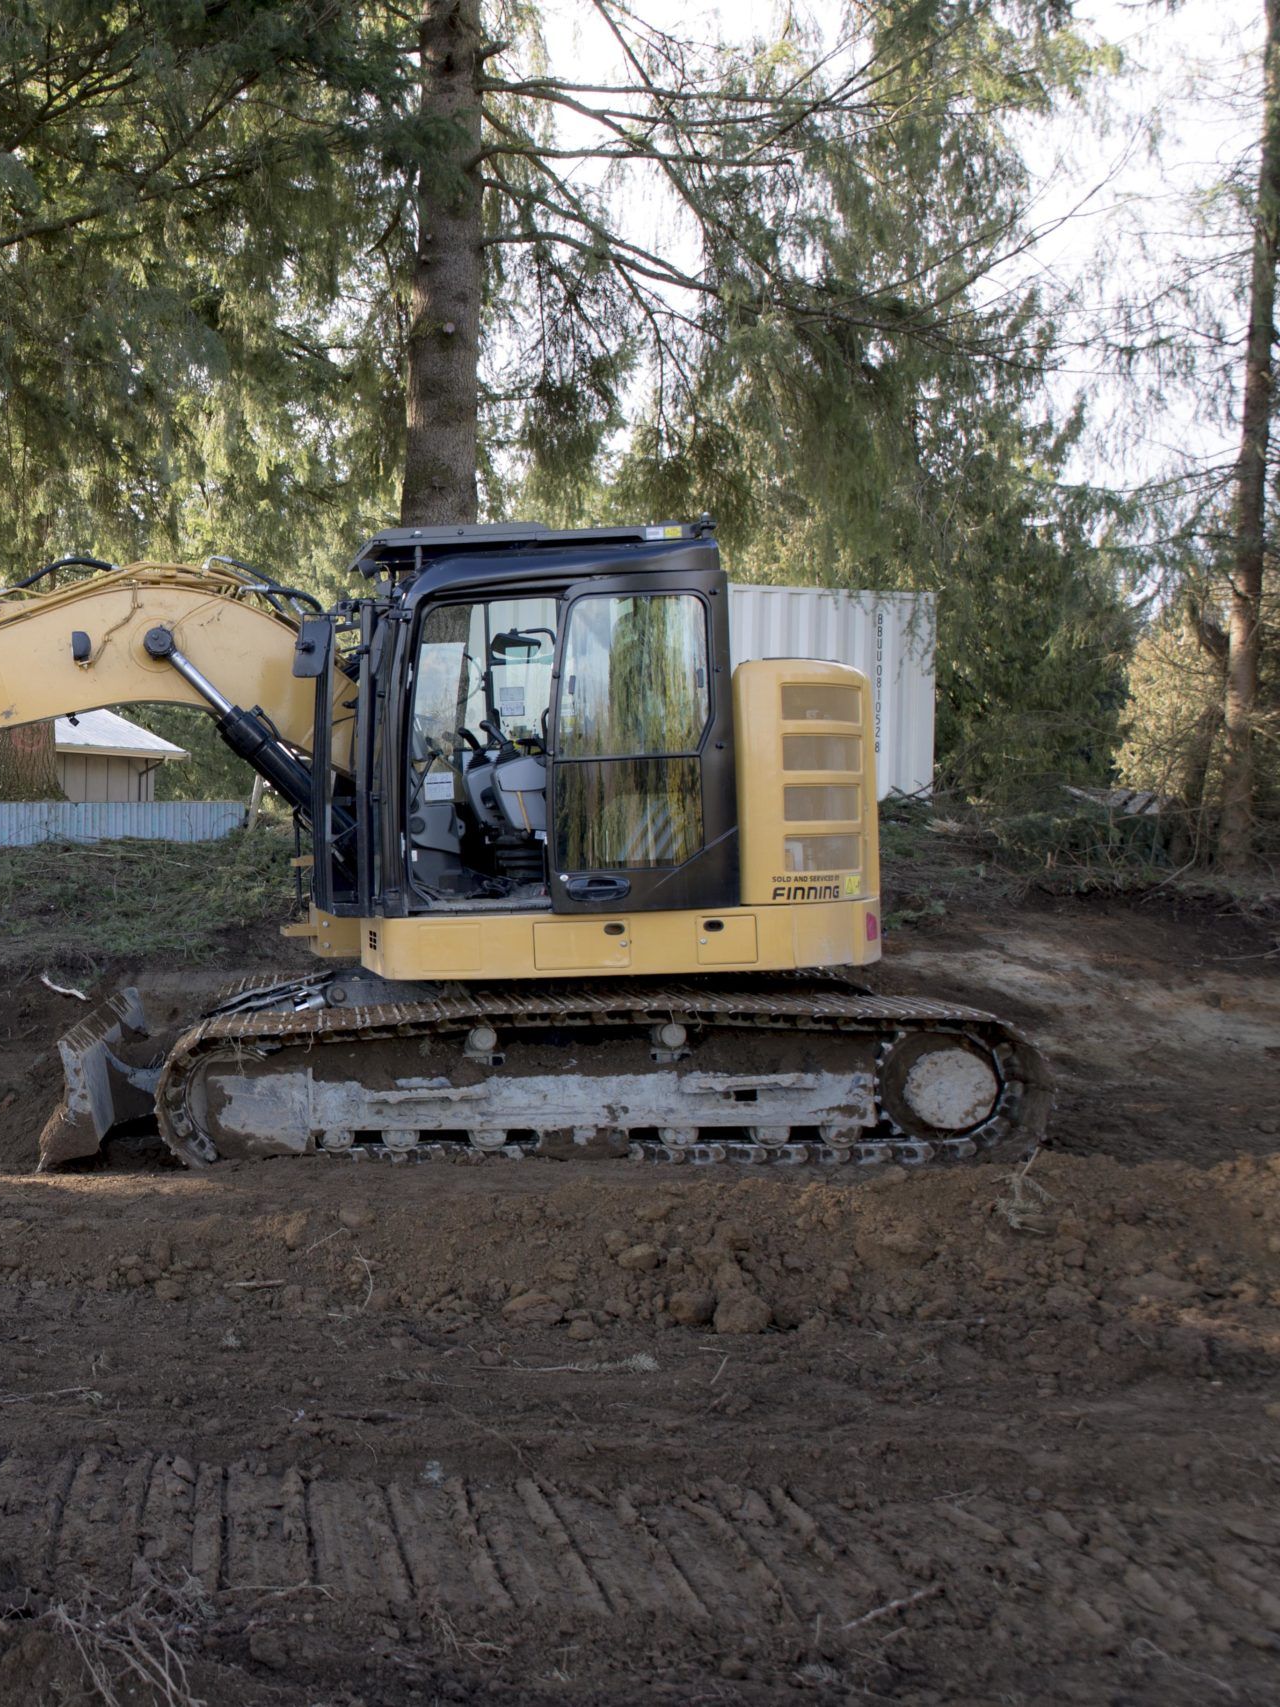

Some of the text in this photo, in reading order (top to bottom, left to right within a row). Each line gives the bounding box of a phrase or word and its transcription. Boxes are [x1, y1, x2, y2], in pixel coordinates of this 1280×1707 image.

[875, 665, 883, 738] 081052
[874, 741, 880, 753] 8
[772, 885, 839, 900] FINNING
